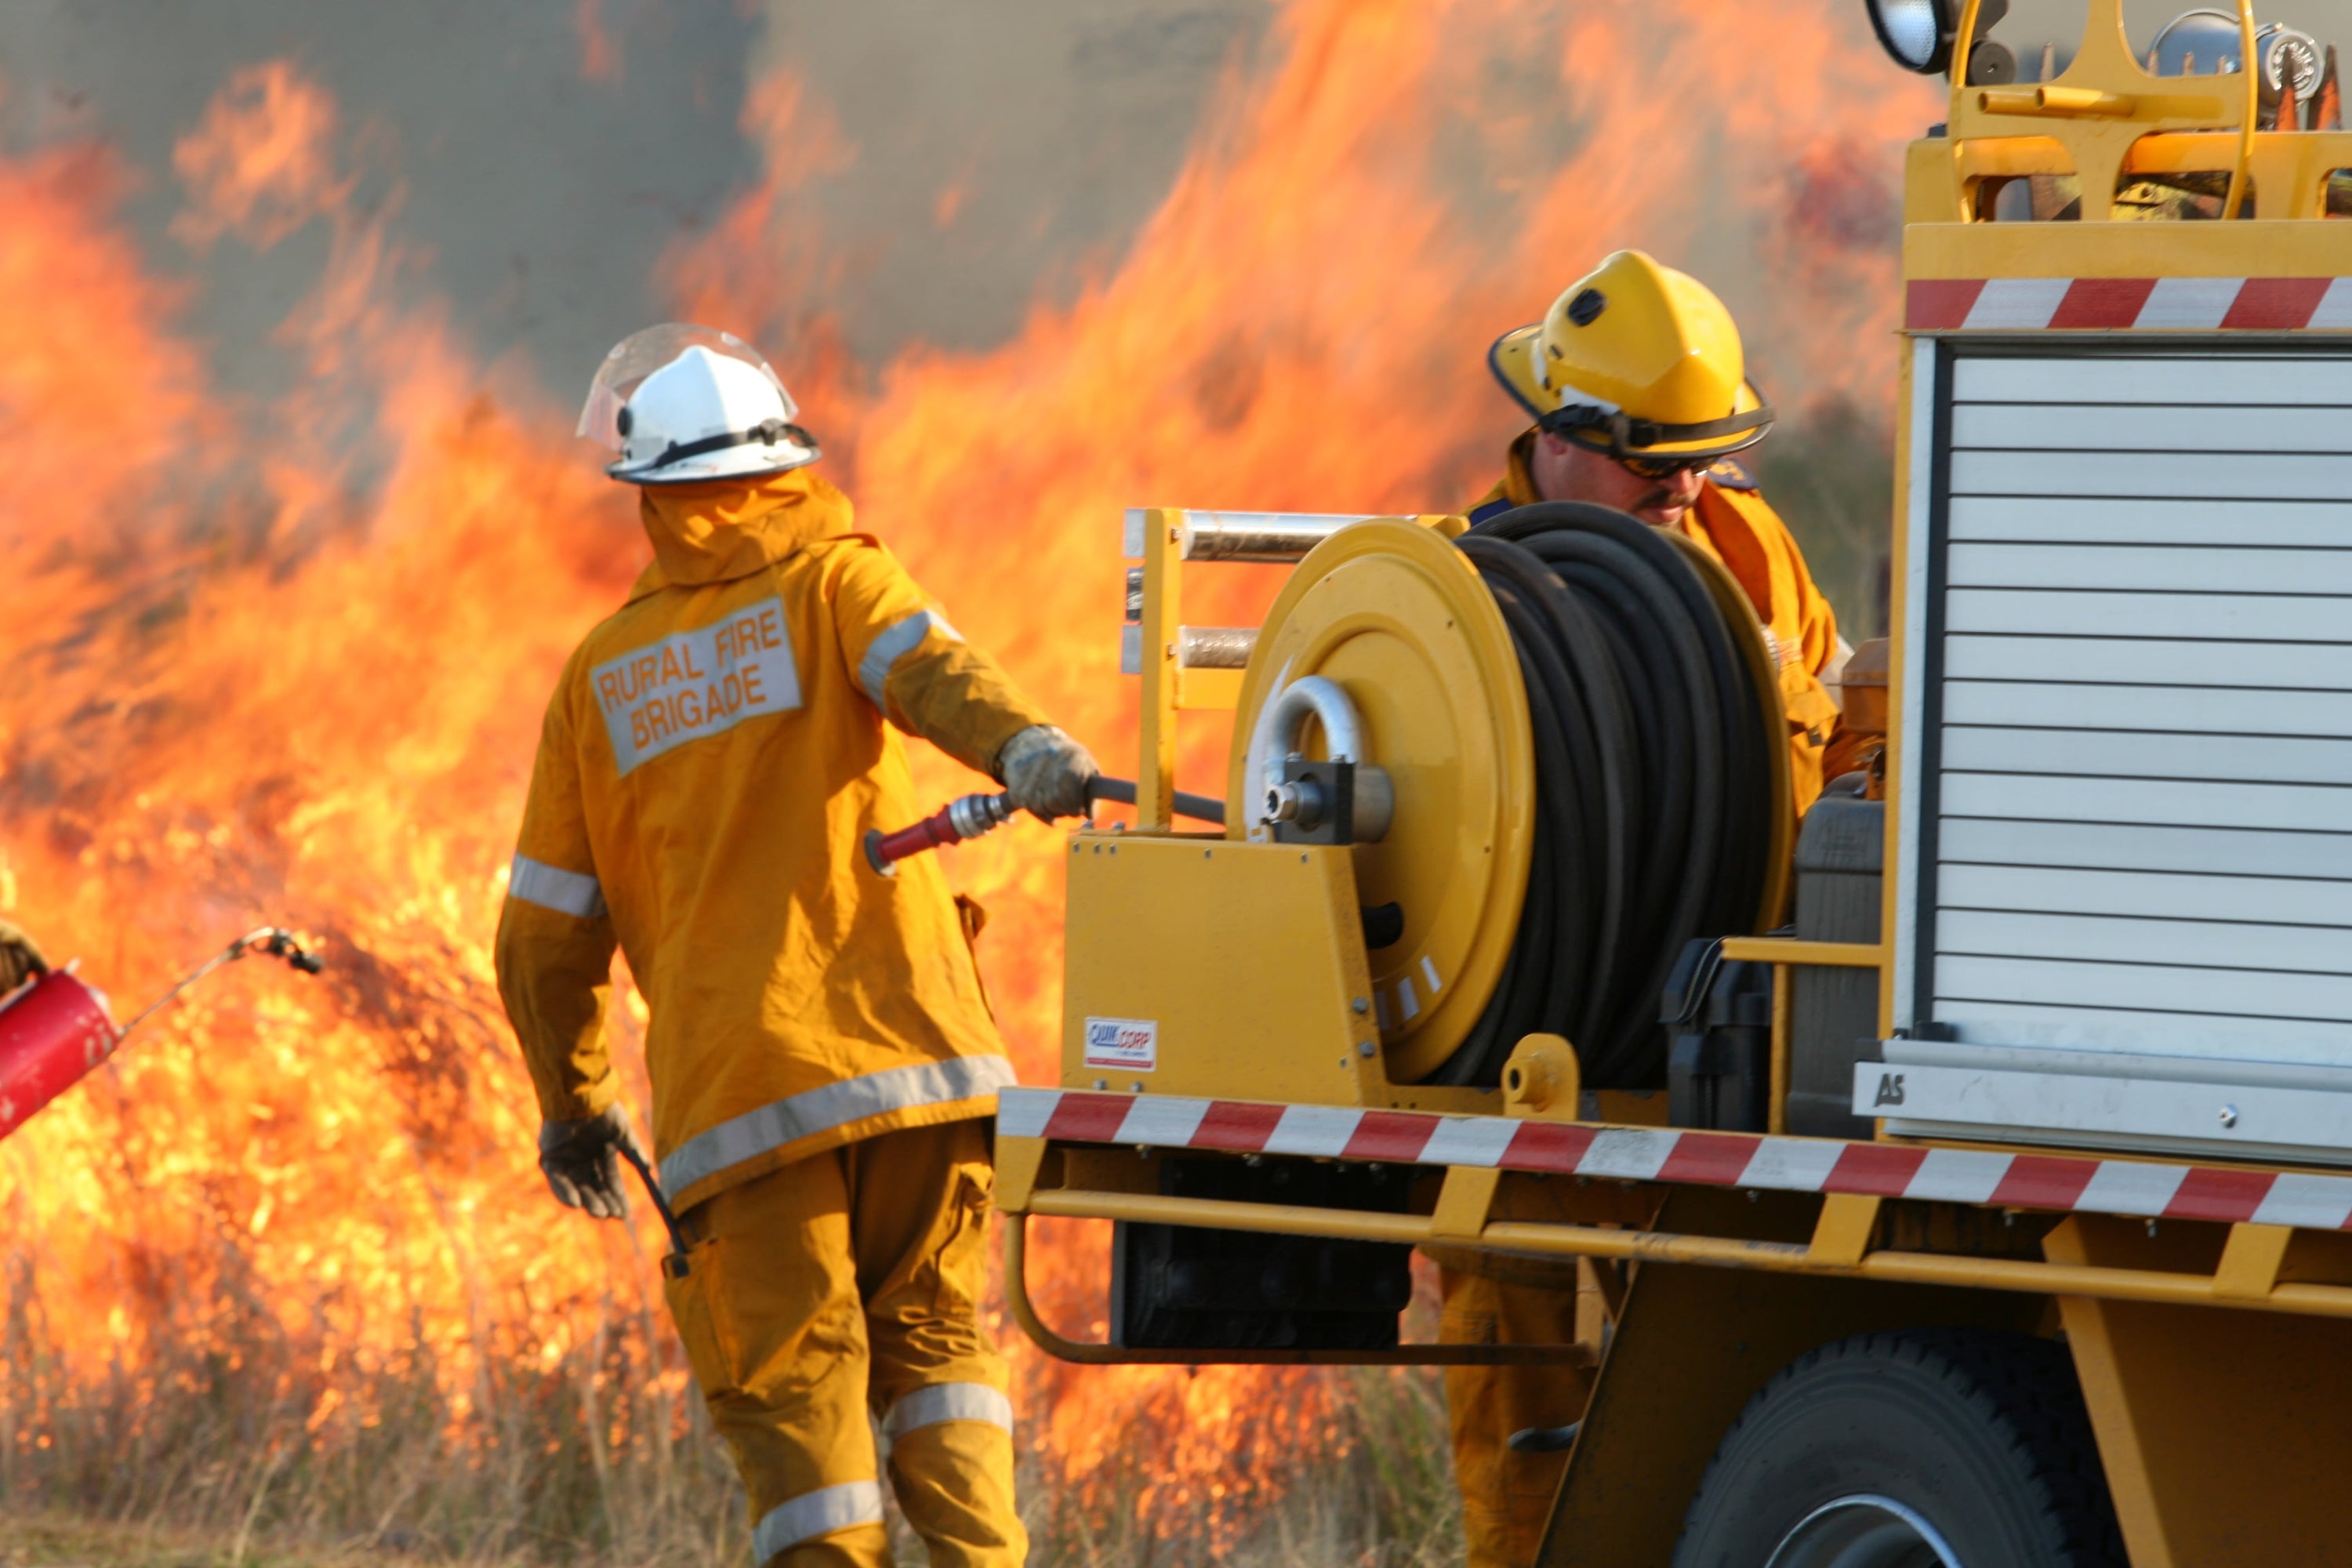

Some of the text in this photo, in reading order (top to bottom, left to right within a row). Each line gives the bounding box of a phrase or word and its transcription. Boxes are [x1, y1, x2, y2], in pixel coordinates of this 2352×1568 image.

[598, 608, 782, 713] RURAL FIRE
[630, 663, 768, 750] BRIGADE
